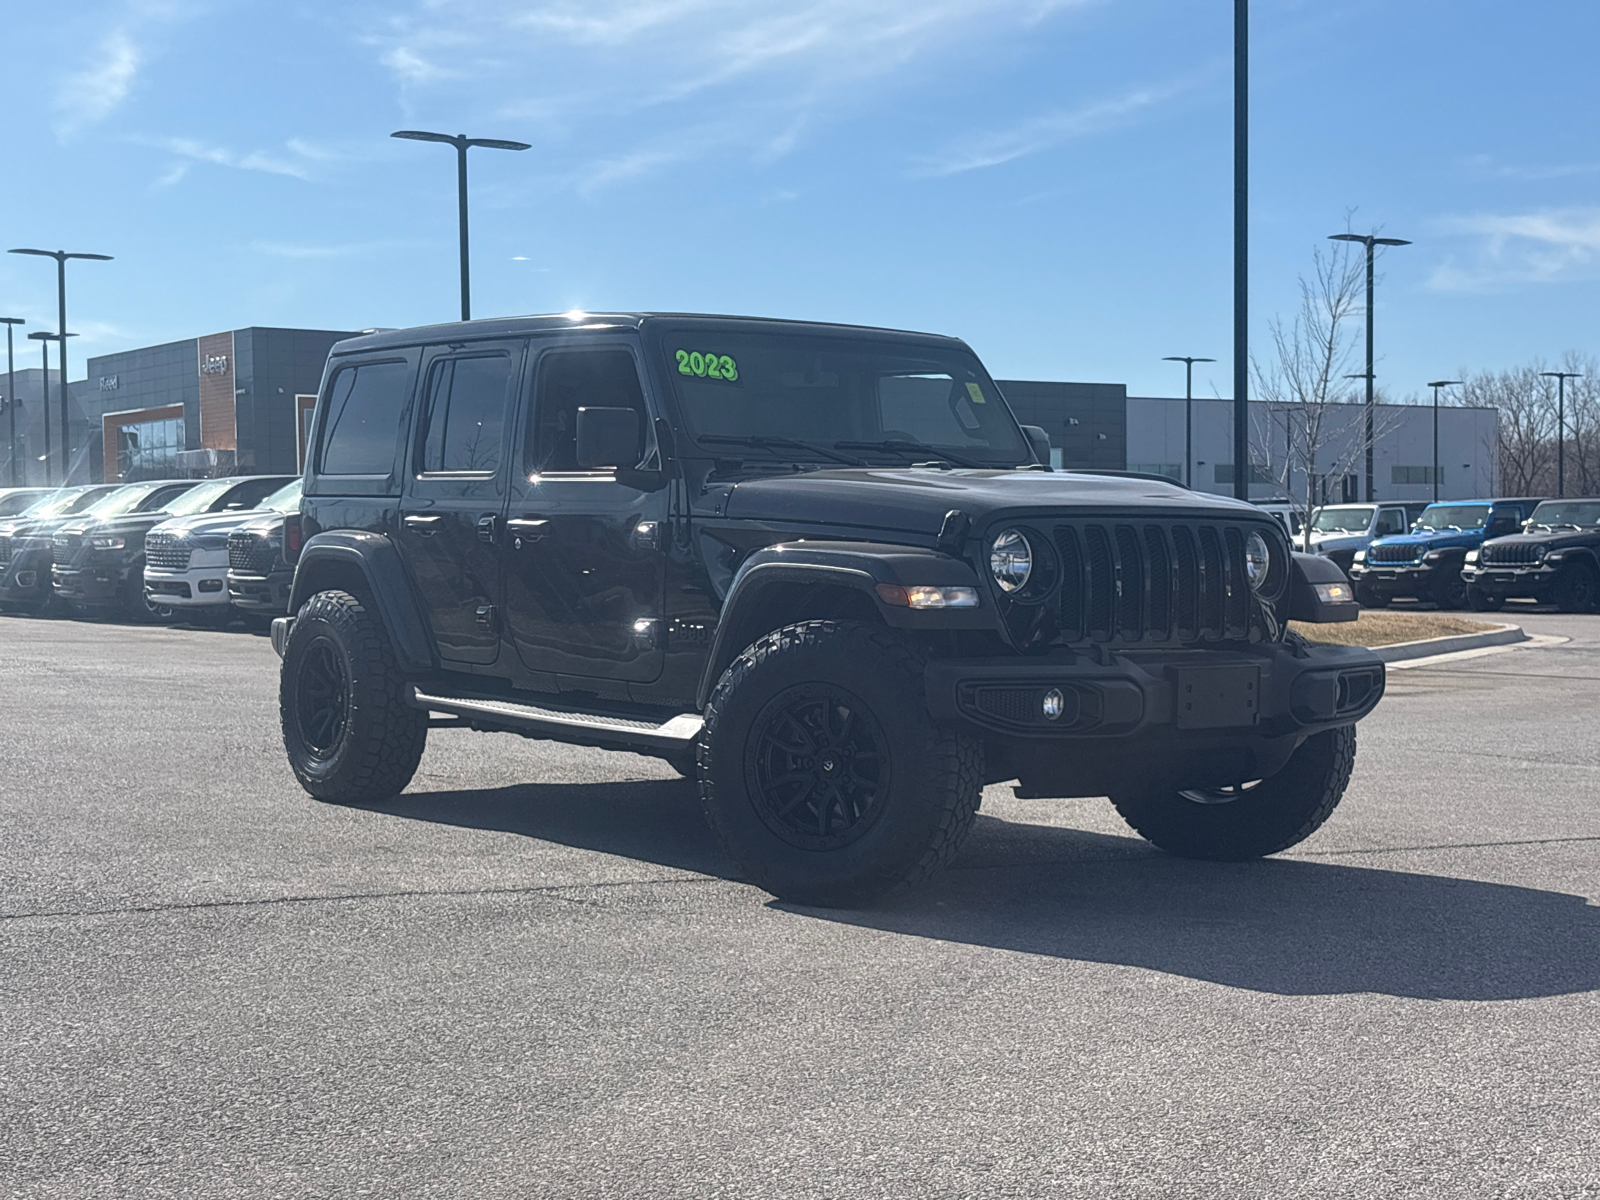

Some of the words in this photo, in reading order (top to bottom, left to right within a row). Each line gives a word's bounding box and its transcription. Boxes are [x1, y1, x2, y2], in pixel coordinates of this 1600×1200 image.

[202, 354, 227, 375] Jeep
[675, 349, 739, 382] 2023
[100, 374, 119, 392] Reed
